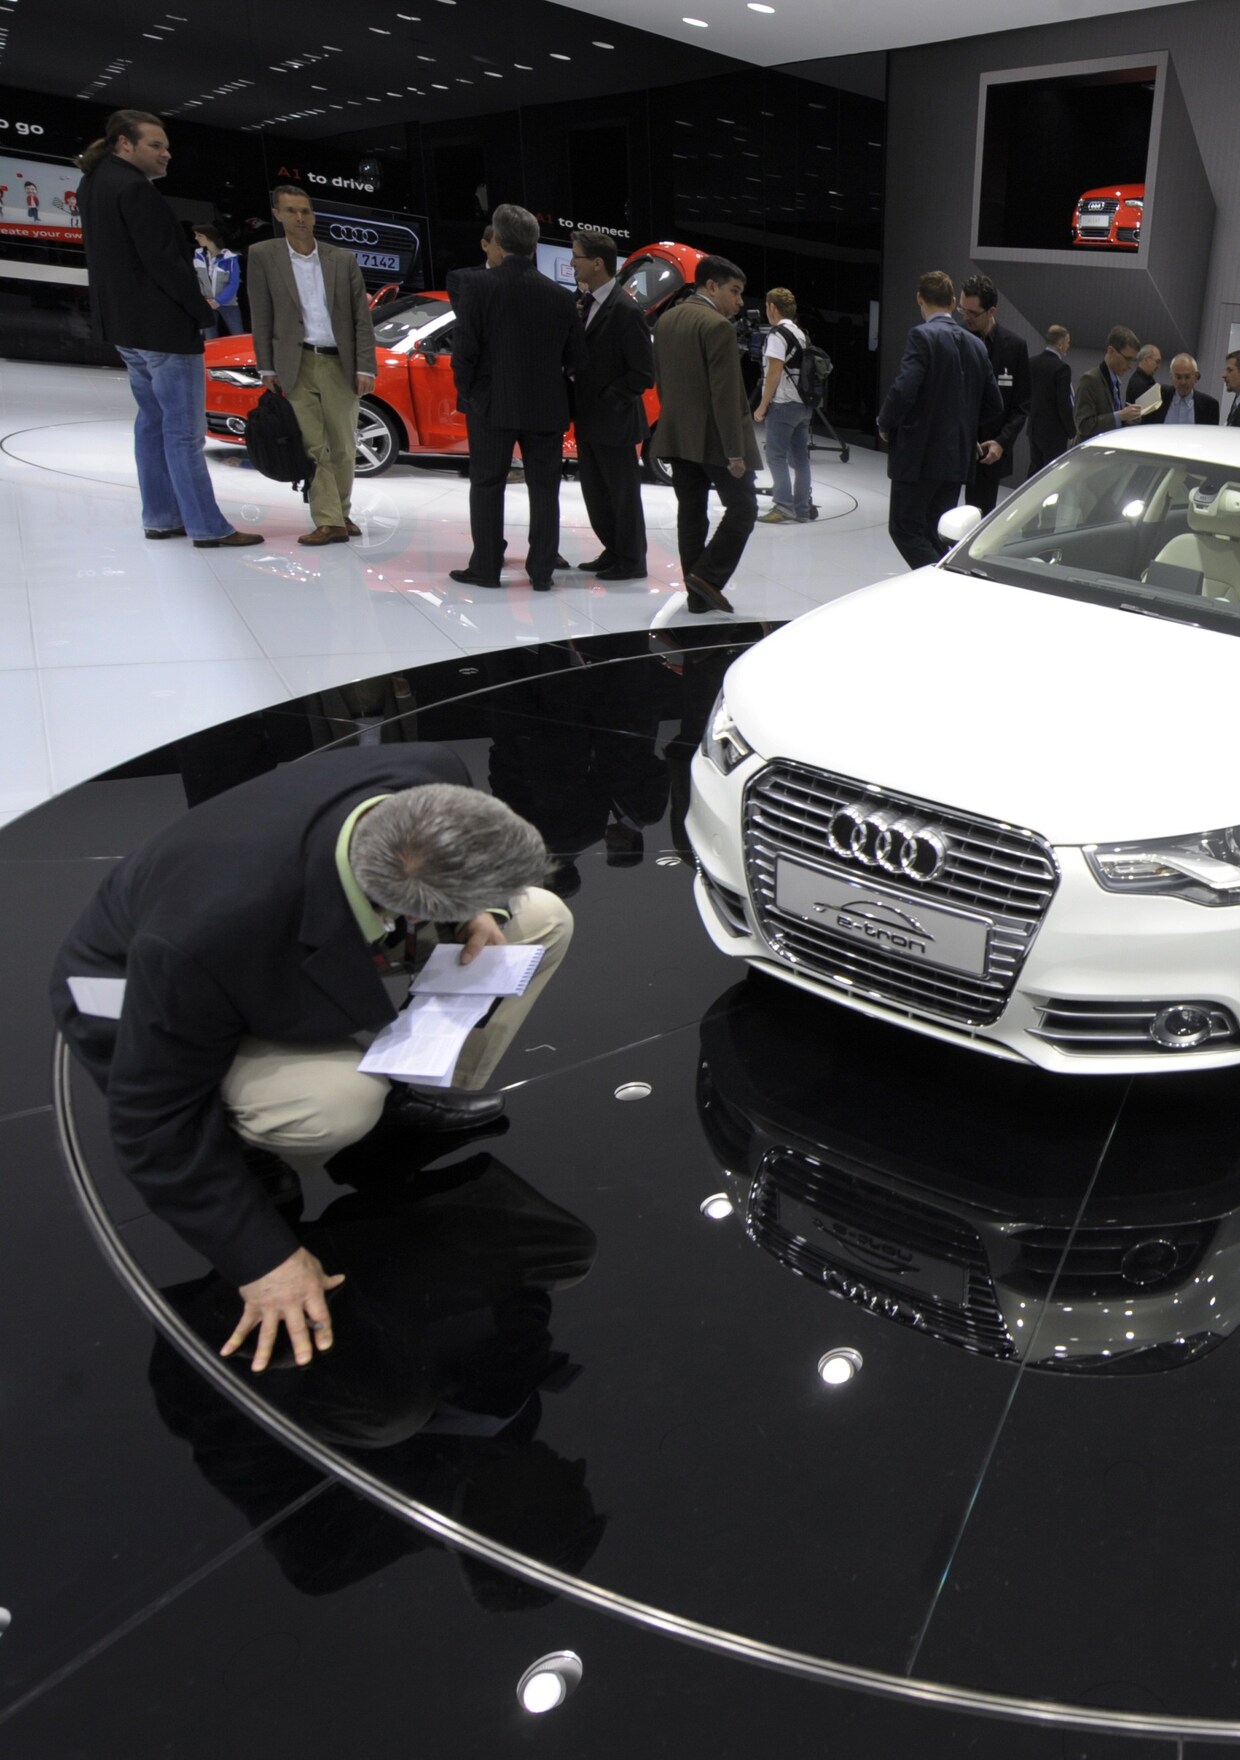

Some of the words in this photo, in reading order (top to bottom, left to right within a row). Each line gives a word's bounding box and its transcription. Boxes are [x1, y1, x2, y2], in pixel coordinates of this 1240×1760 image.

[0, 119, 9, 129] o
[15, 122, 44, 135] go
[277, 166, 302, 180] A1
[307, 172, 327, 184] to
[331, 176, 374, 192] drive
[0, 227, 29, 236] eate
[32, 229, 61, 239] your
[558, 217, 574, 228] to
[577, 222, 630, 238] connect
[362, 253, 395, 269] 7142
[837, 915, 925, 953] e-tron
